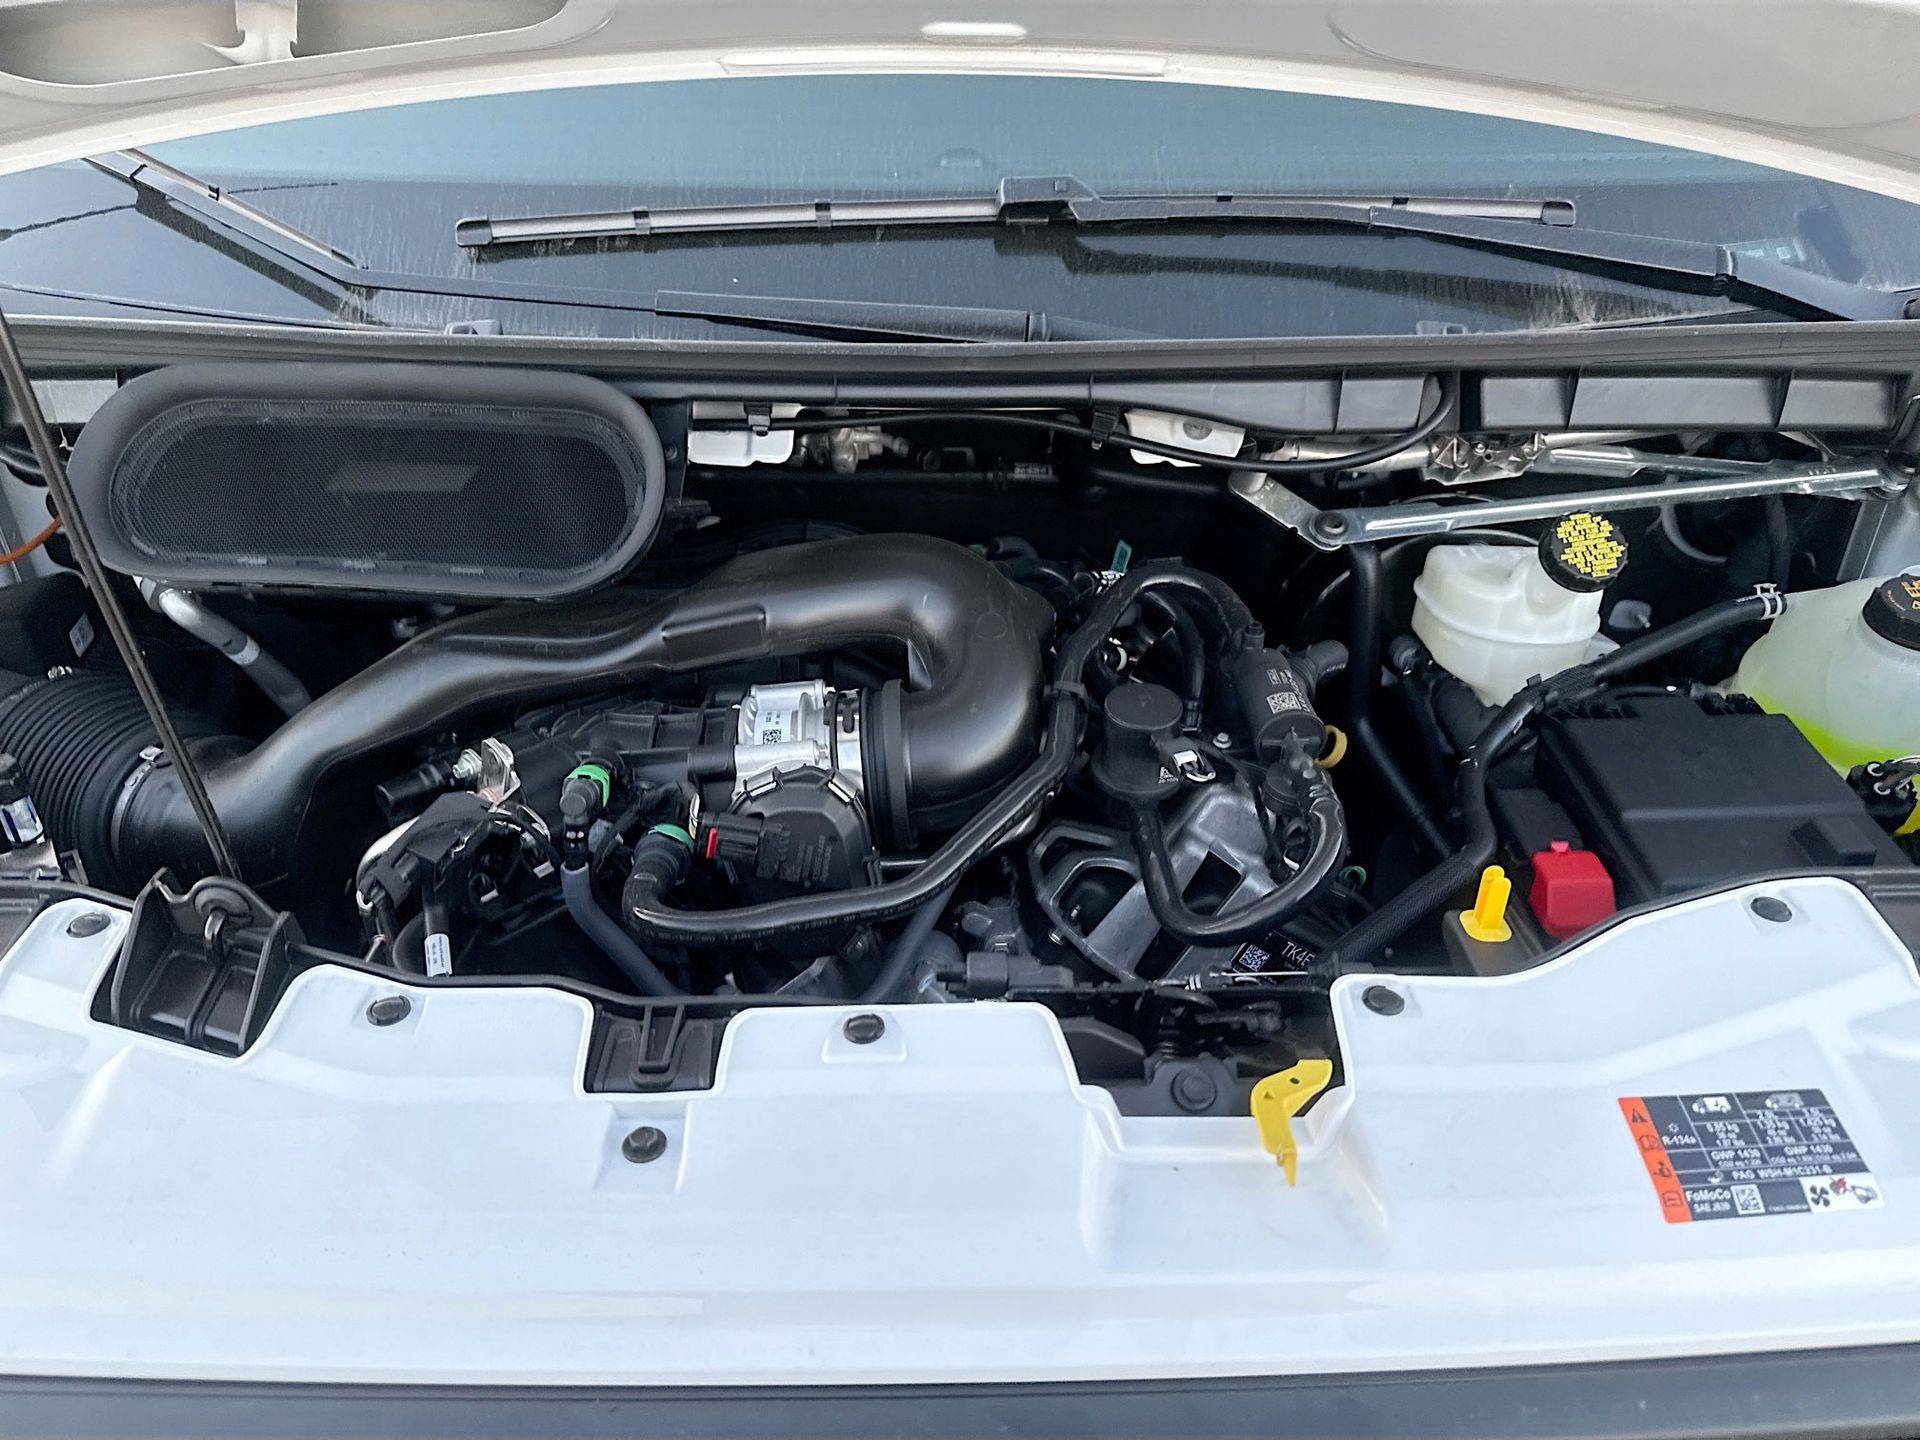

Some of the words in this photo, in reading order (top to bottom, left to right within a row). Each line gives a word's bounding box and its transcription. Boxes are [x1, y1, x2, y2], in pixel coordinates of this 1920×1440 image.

[1726, 1121, 1740, 1133] kg
[1662, 1134, 1696, 1145] R-134a
[1711, 1150, 1736, 1160] GWP
[1737, 1148, 1761, 1158] 1430
[1784, 1145, 1808, 1156] GWP
[1810, 1144, 1834, 1154] 1430
[1732, 1170, 1756, 1180] PAG
[1685, 1188, 1732, 1202] FoMoCo
